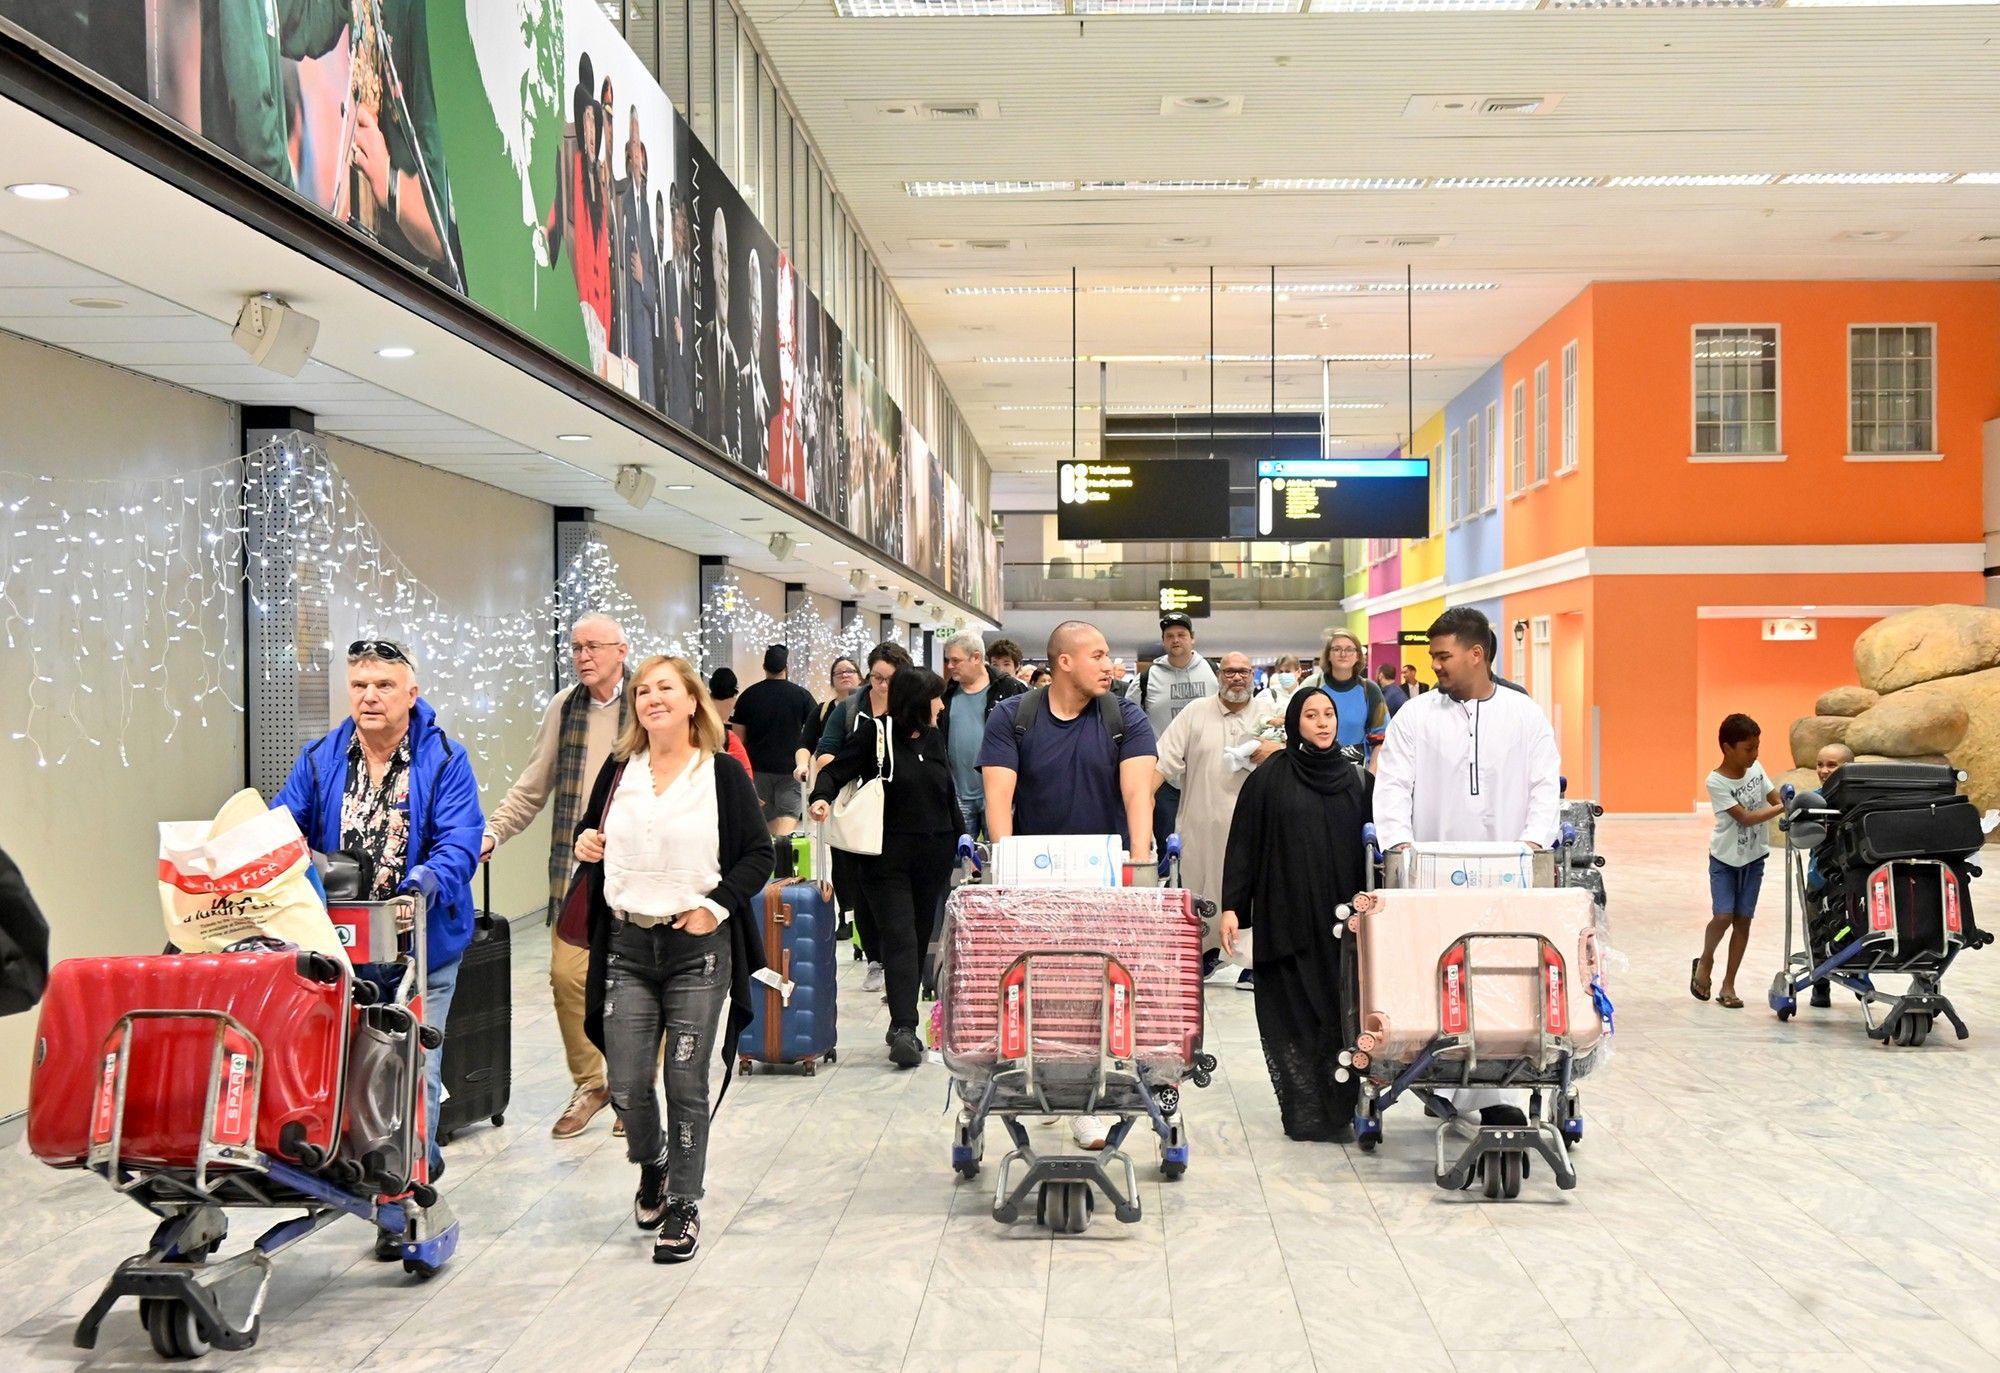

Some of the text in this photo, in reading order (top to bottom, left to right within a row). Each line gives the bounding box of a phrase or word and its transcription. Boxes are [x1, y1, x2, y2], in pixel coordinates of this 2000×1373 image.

[691, 157, 704, 413] STATESMAN
[241, 862, 279, 885] Free
[196, 906, 246, 920] luxury
[1449, 979, 1459, 1015] SPAR
[1551, 980, 1560, 1016] SPAR
[1010, 1000, 1018, 1038] SPAR
[1115, 1000, 1124, 1037] SPAR
[101, 1072, 115, 1118] SPAR
[227, 1073, 243, 1120] SPAR
